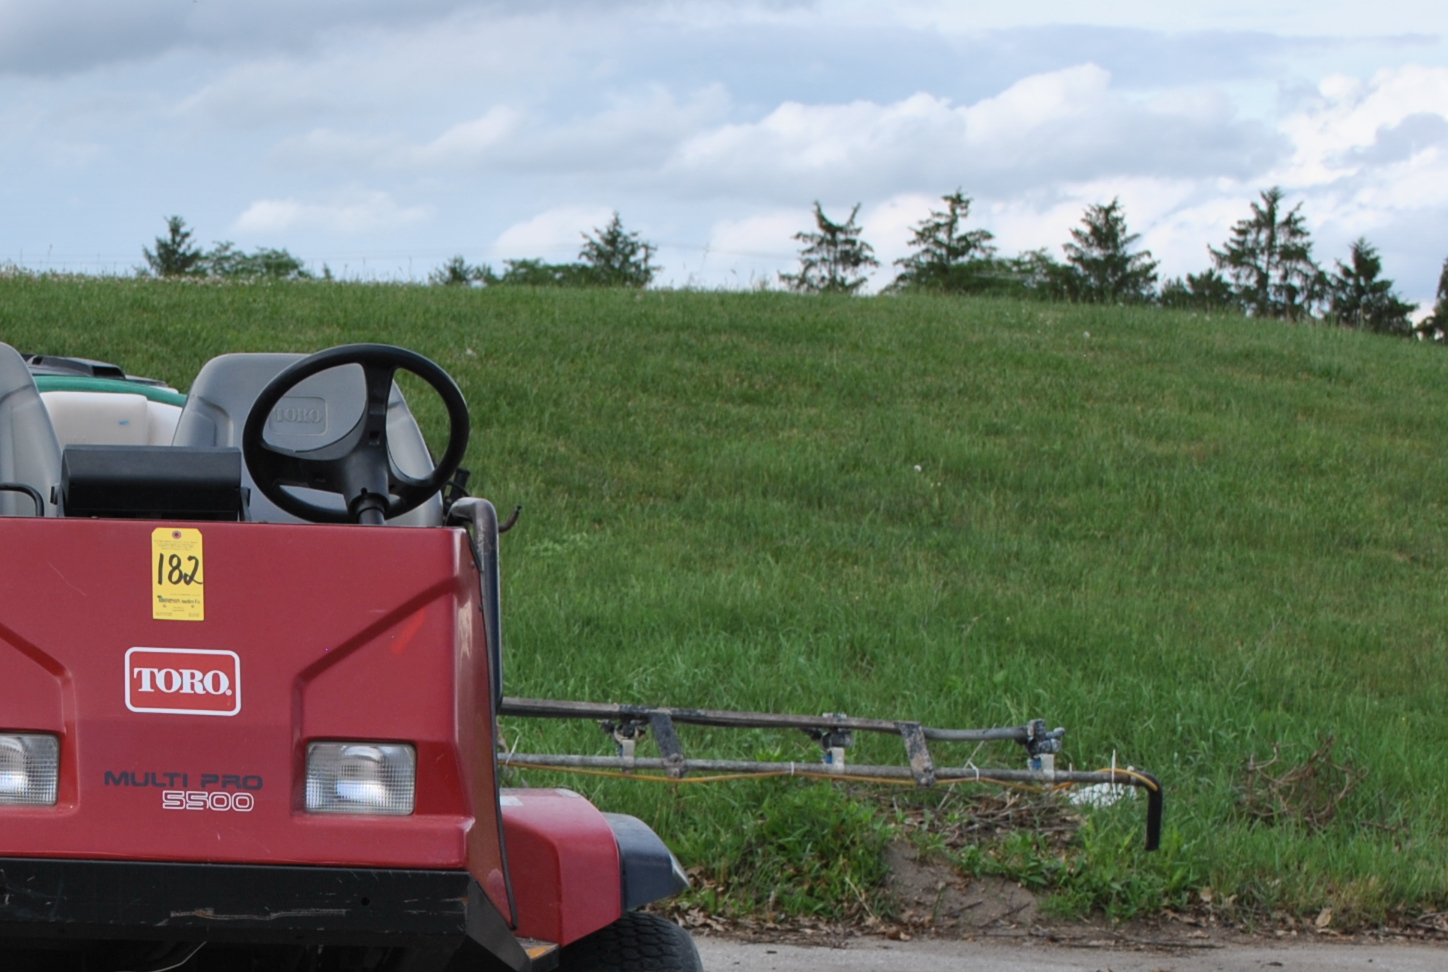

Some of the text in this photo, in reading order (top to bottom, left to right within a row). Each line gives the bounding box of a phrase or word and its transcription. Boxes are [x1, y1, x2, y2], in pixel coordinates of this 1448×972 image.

[272, 407, 322, 423] TORO
[157, 553, 203, 585] 182
[133, 667, 230, 695] TORO
[104, 770, 263, 790] MULTI PRO
[162, 790, 254, 812] 5500
